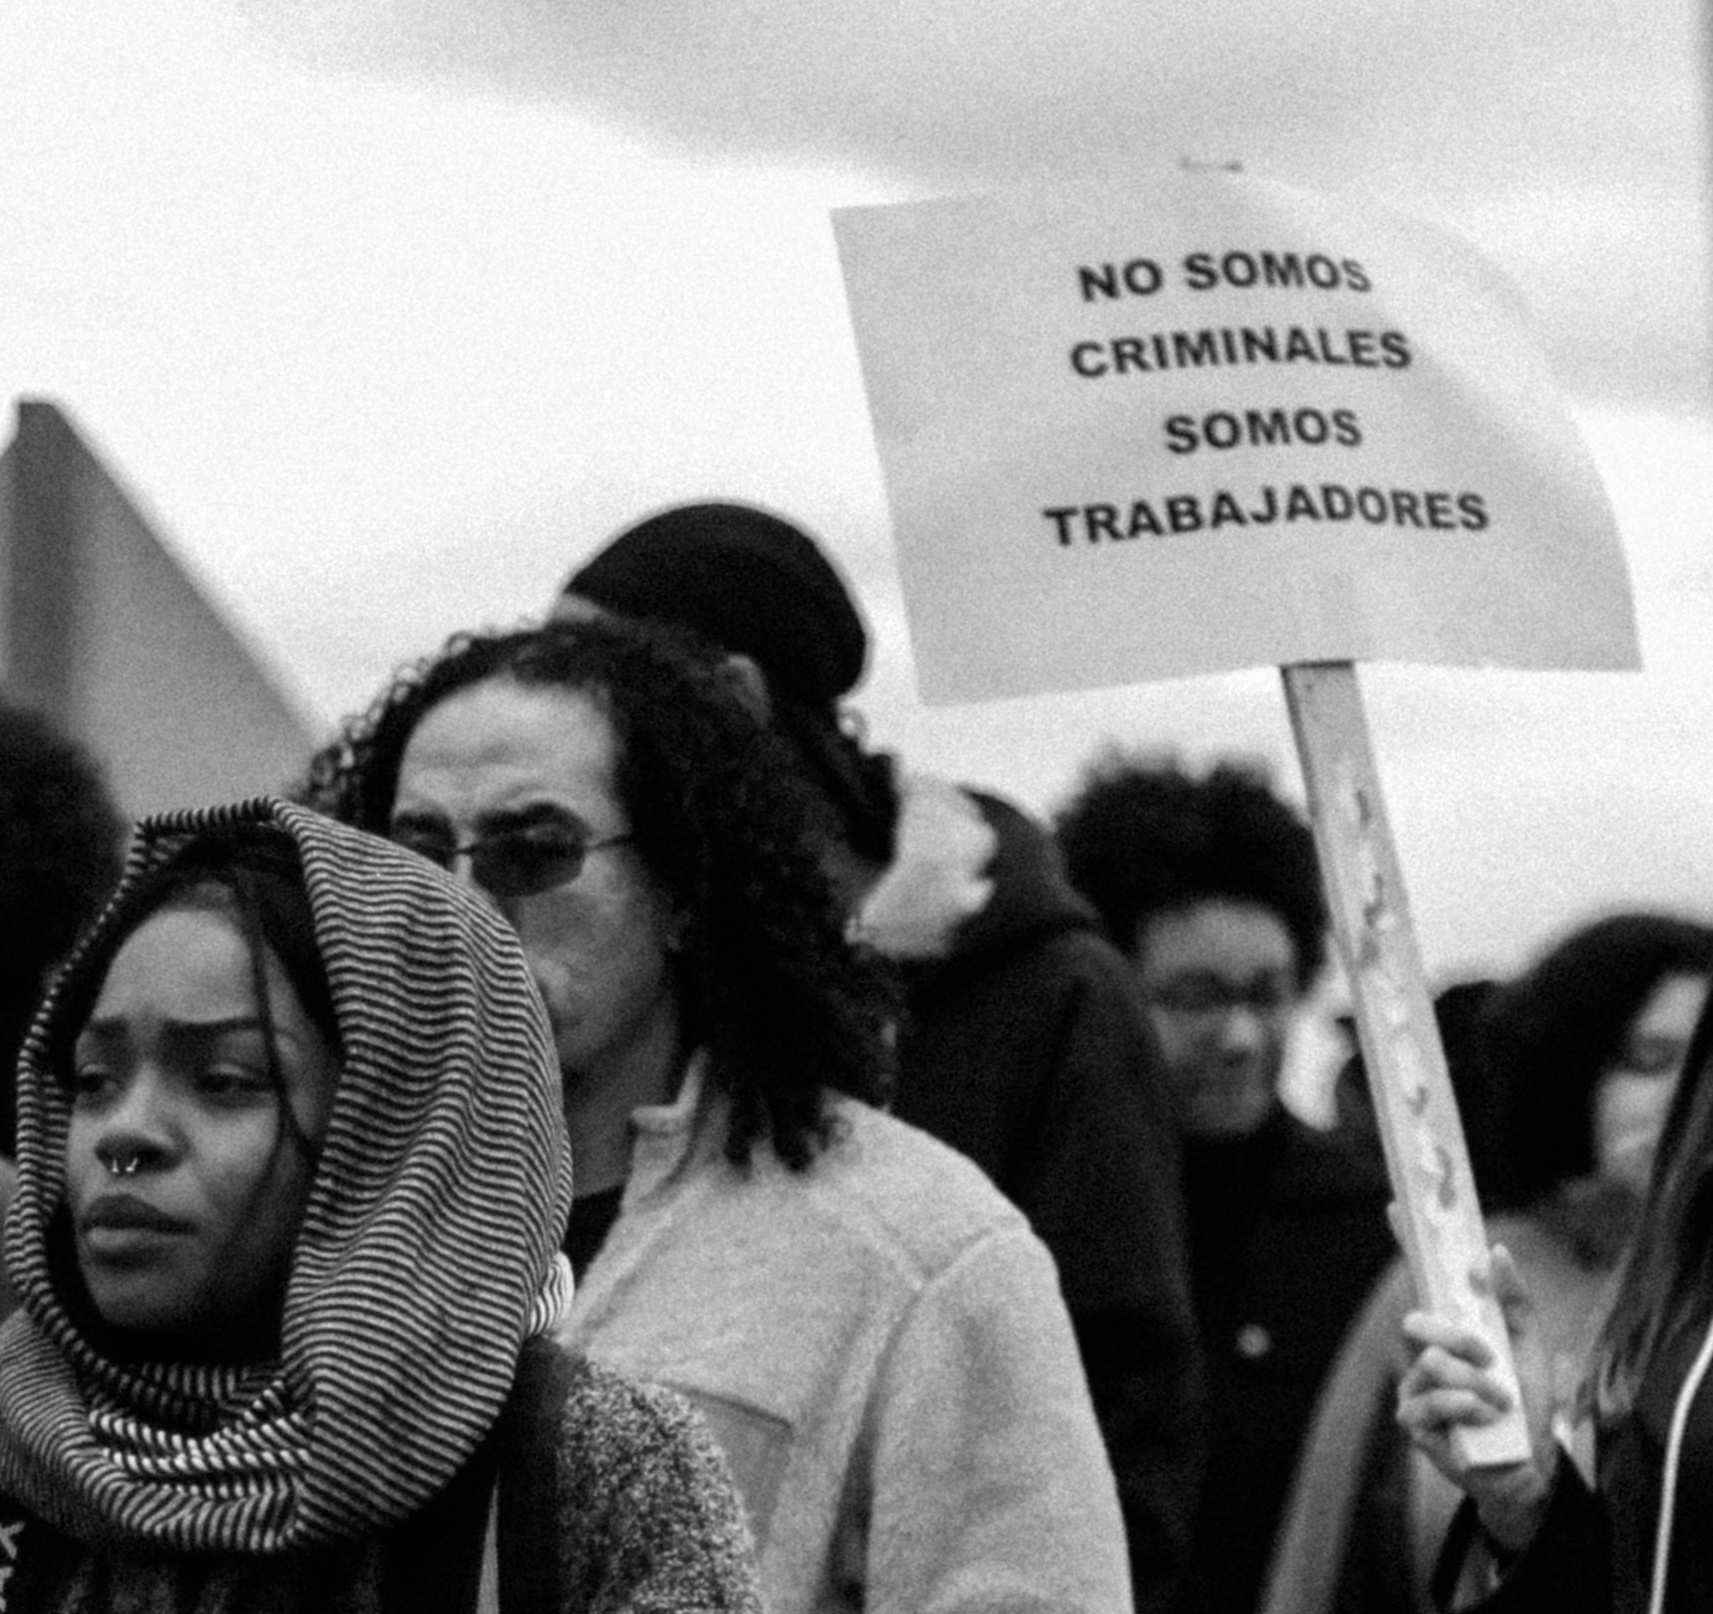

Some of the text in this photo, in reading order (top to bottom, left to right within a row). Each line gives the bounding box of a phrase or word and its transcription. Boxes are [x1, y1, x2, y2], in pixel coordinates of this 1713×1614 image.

[1077, 249, 1372, 303] NO SOMOS
[1069, 326, 1413, 379] CRIMINALES
[1163, 407, 1363, 456] SOMOS
[1041, 483, 1490, 547] TRABAJADORES
